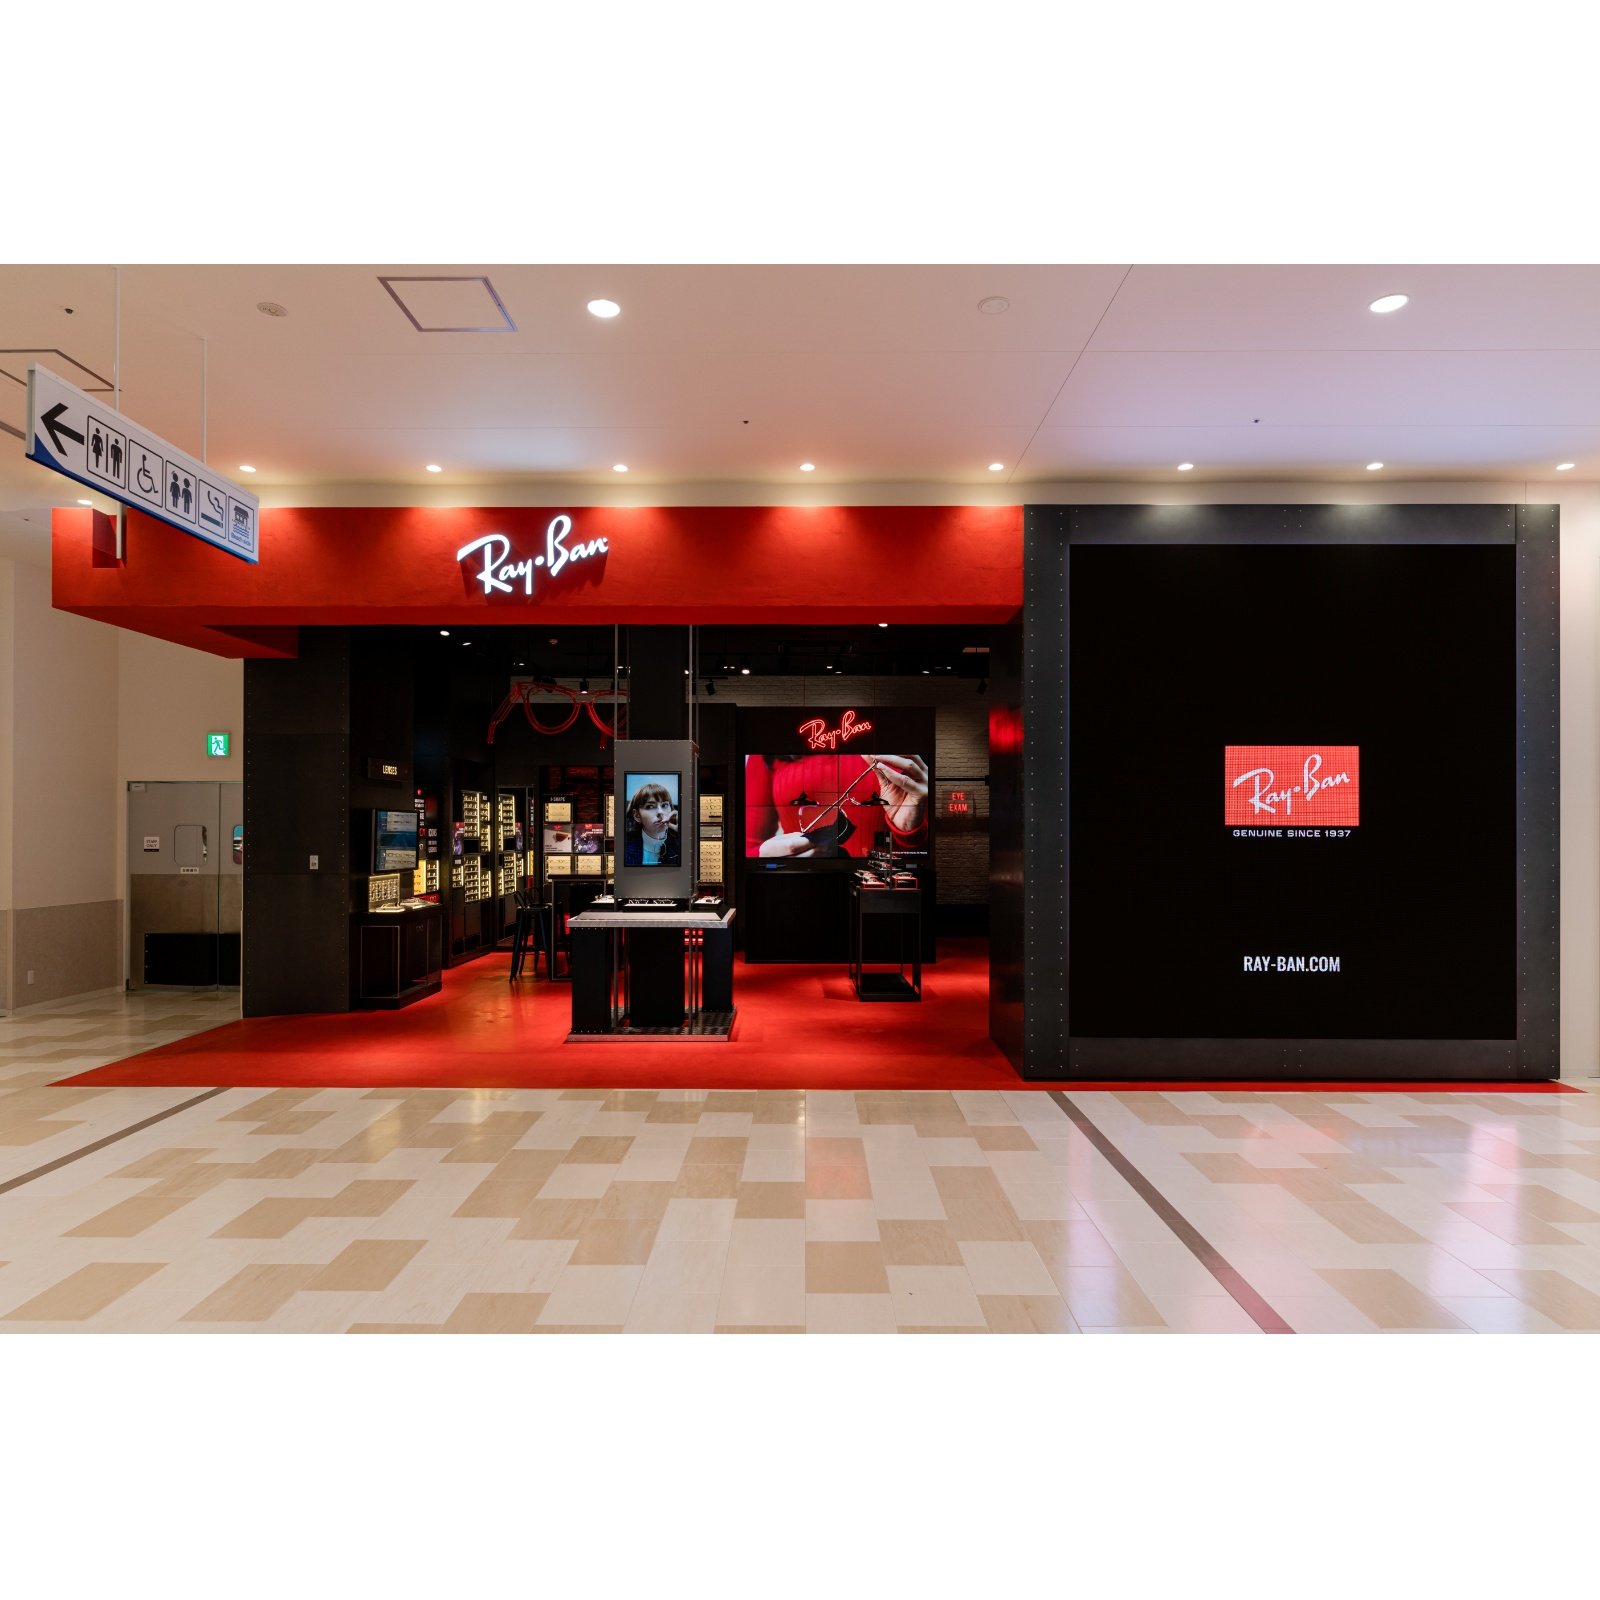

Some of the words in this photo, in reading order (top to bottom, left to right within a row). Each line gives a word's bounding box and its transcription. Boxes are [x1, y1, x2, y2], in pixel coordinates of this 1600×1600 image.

[382, 764, 398, 776] LENSES
[951, 792, 965, 801] EYE
[949, 803, 968, 812] EXAM
[1232, 829, 1283, 838] GENUINE
[1287, 829, 1321, 838] SINCE
[1324, 829, 1352, 838] 1937
[1243, 956, 1341, 972] RAY-BAN.COM
